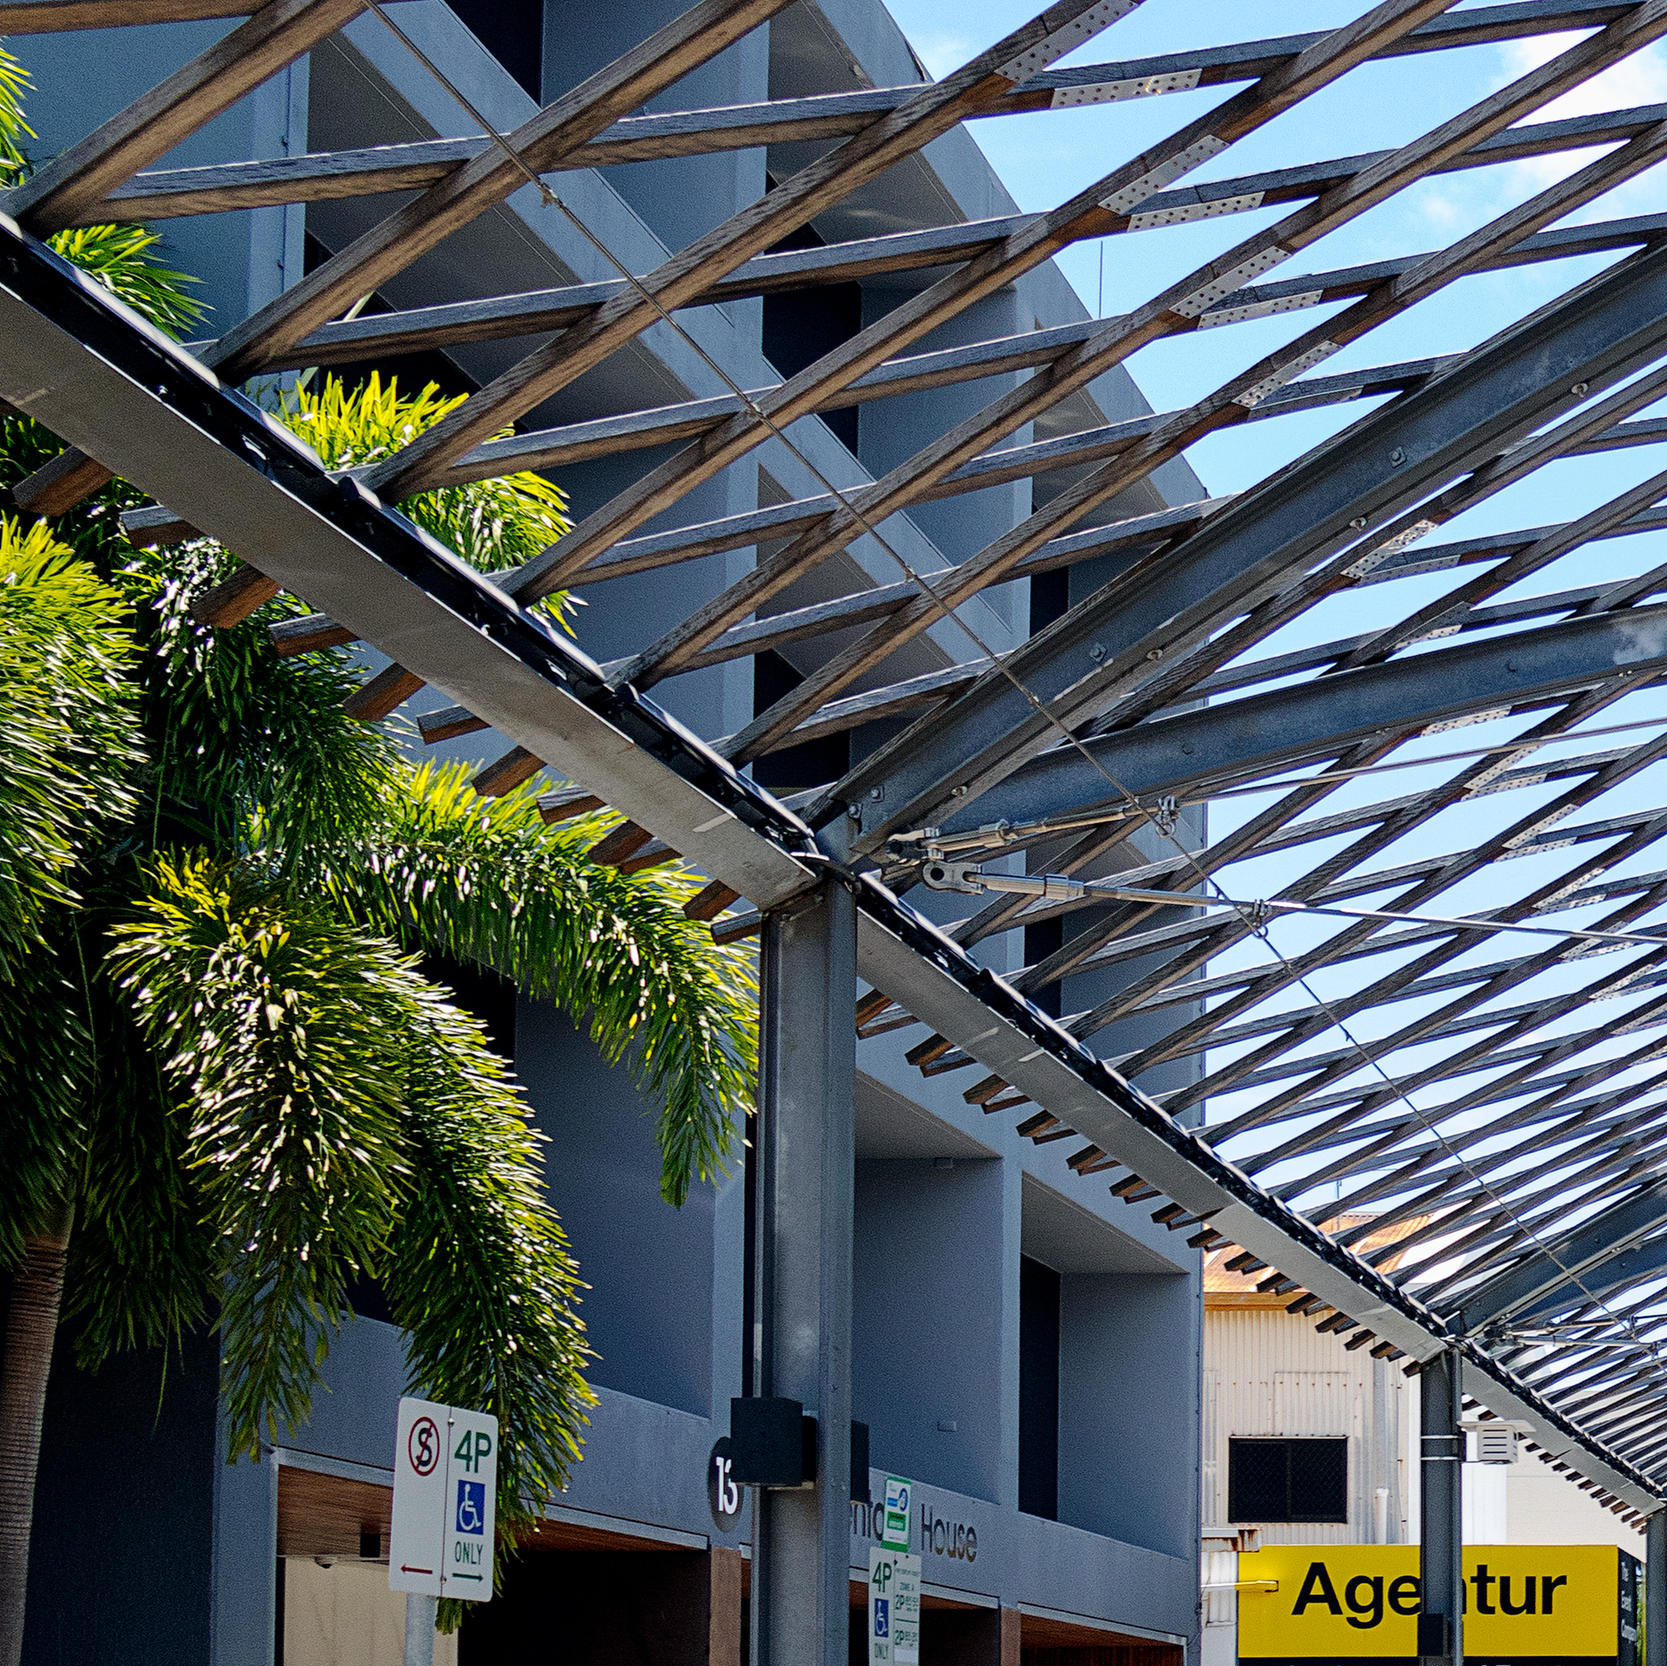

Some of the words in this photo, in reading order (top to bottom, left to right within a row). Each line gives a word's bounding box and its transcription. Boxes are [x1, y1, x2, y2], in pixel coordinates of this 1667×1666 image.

[454, 1430, 492, 1474] 4P
[716, 1456, 739, 1515] 13
[454, 1541, 484, 1566] ONLY
[921, 1503, 977, 1563] House
[872, 1561, 892, 1593] 4P
[1291, 1561, 1568, 1630] Agetur
